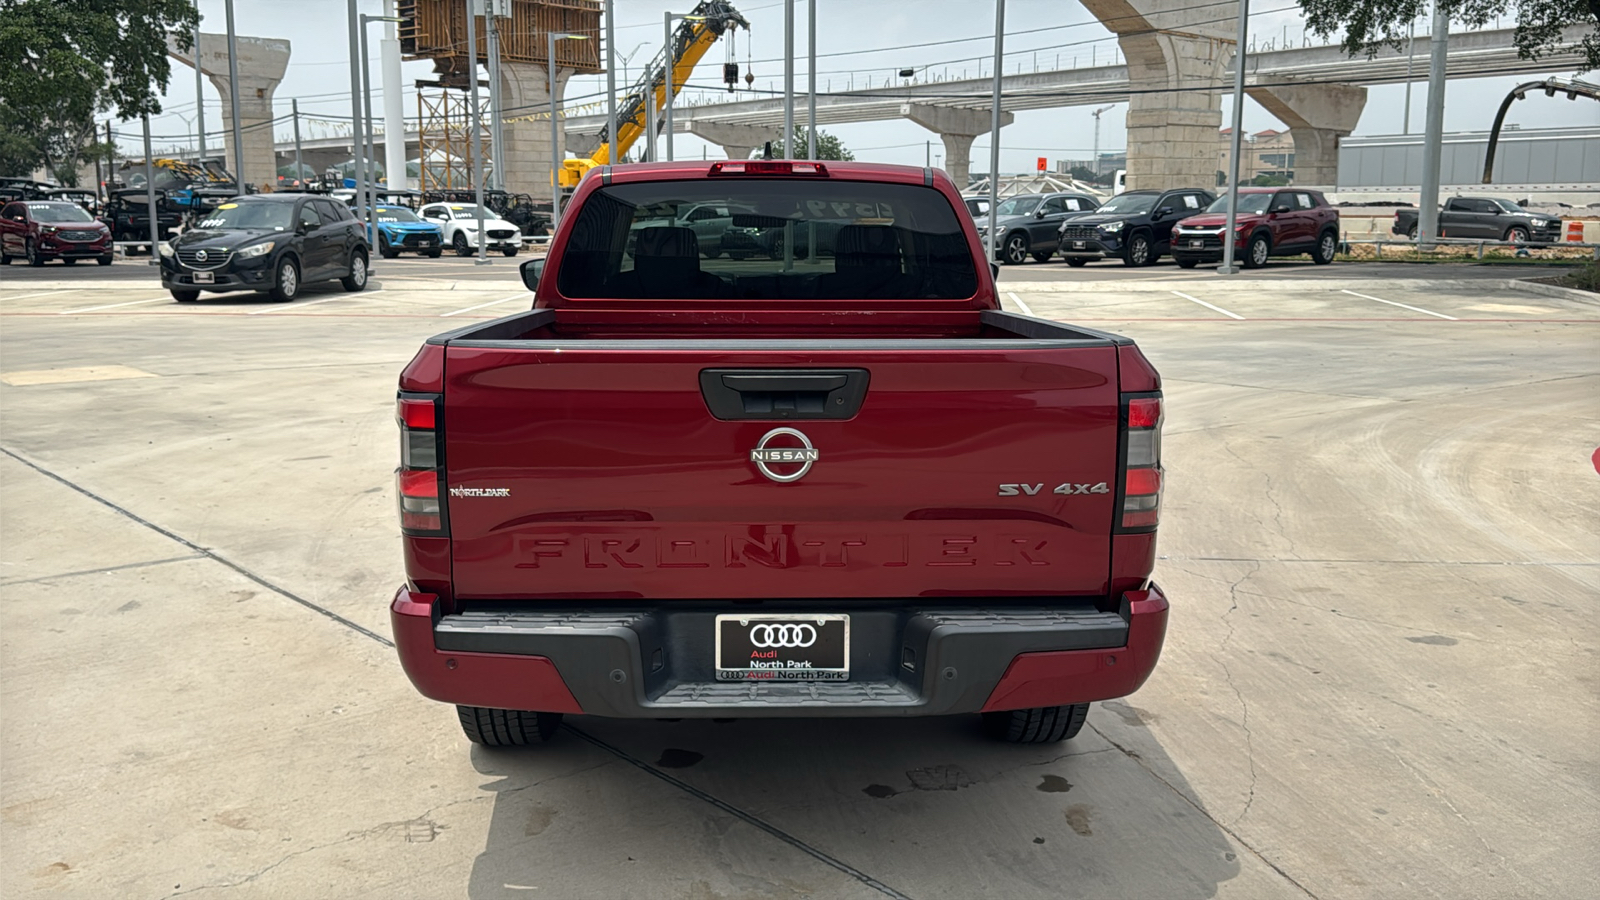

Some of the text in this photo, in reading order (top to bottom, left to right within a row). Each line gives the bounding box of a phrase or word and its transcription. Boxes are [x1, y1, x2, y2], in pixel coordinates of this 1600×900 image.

[752, 451, 817, 460] NISSAN
[998, 483, 1045, 496] SV
[513, 535, 1051, 568] FRONTIER
[750, 649, 778, 659] Audi
[750, 660, 812, 669] North Park
[746, 670, 844, 680] Audi North Park
